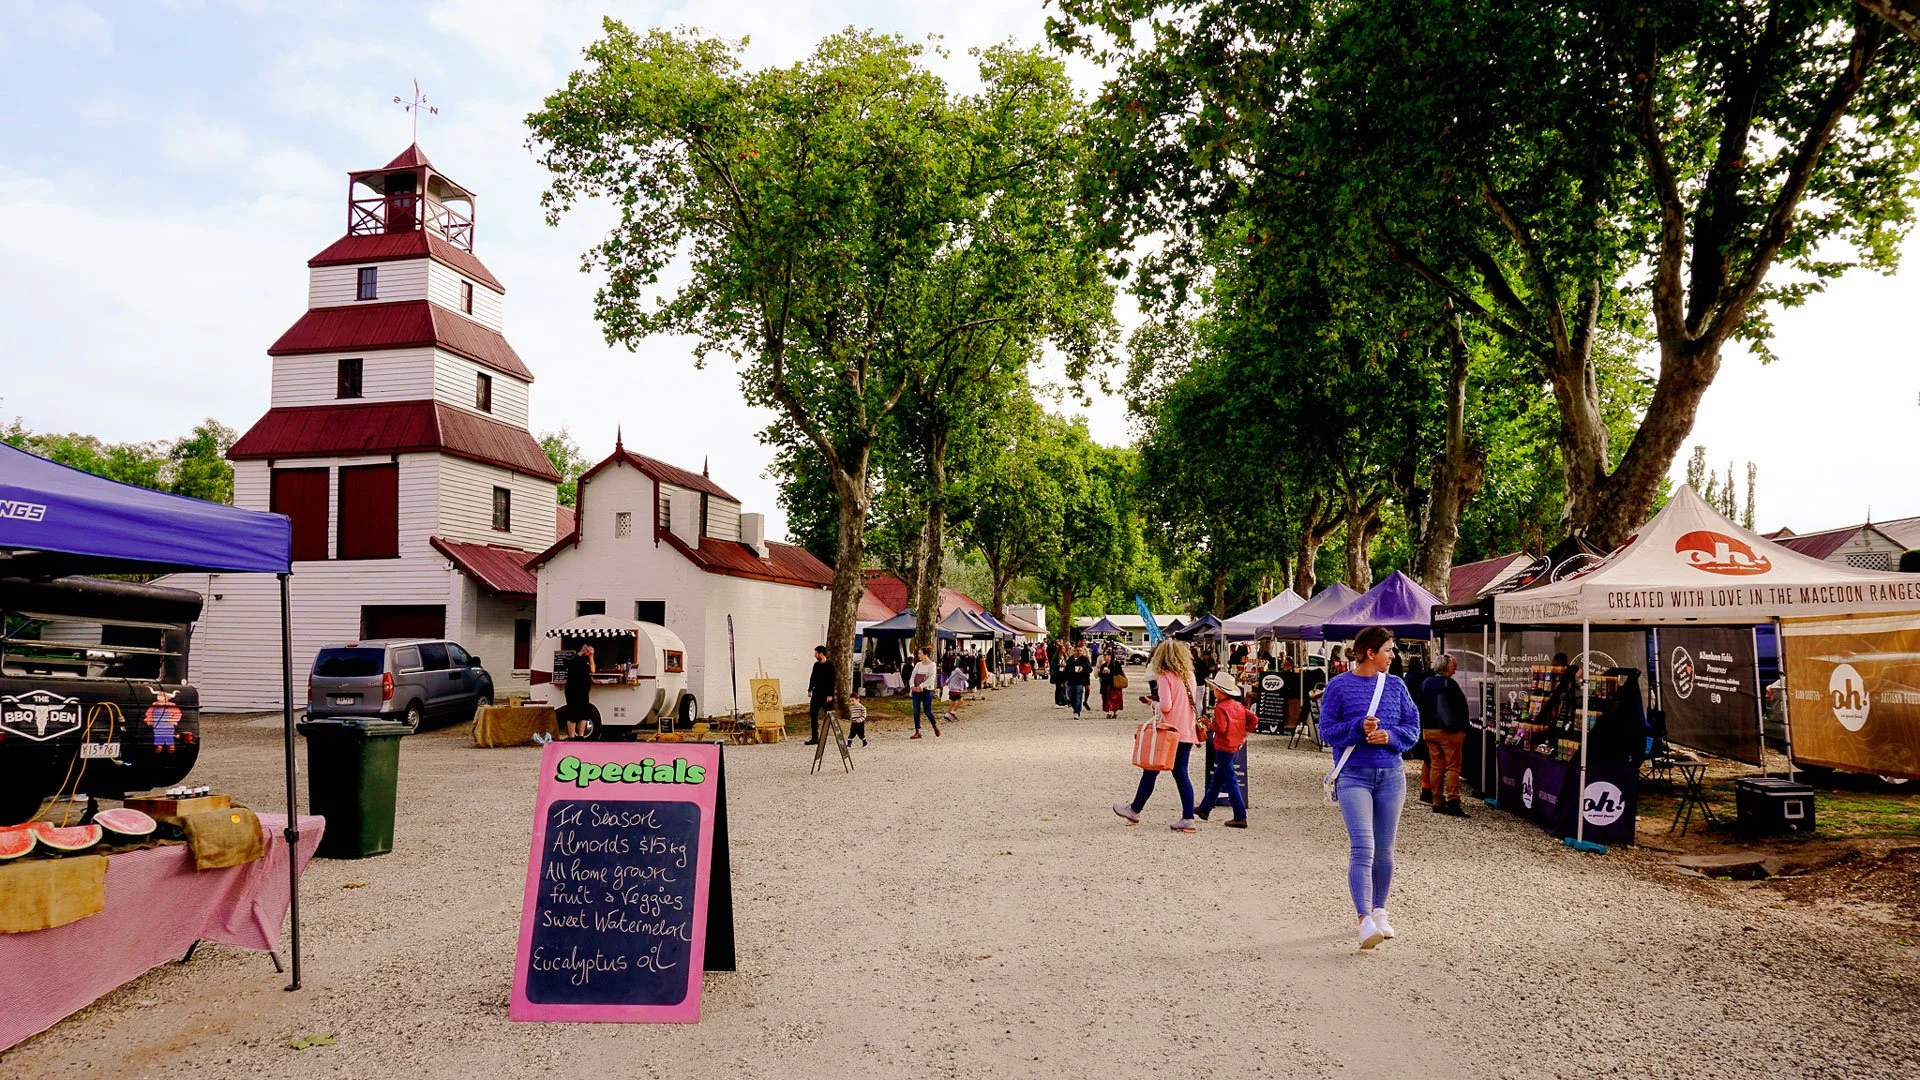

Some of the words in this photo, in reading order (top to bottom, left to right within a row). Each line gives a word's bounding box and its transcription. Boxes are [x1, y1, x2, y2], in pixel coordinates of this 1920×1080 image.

[1608, 591, 1665, 609] CREATED
[1671, 590, 1704, 607] WITH
[1711, 589, 1743, 606] LOVE
[1750, 588, 1763, 605] IN
[1769, 588, 1793, 605] THE
[1800, 585, 1863, 604] MACEDON
[1870, 582, 1920, 601] RANGES
[33, 695, 50, 703] THE
[5, 711, 34, 723] BBQ
[50, 711, 77, 724] DEN
[554, 756, 707, 788] Specials
[553, 803, 583, 828] In
[591, 803, 662, 829] Season
[552, 831, 630, 856] Almonds
[545, 861, 567, 881] All
[570, 859, 608, 881] home
[613, 868, 676, 890] grown
[549, 882, 594, 905] fruit
[542, 909, 590, 929] Sweet
[594, 909, 693, 941] Watermelon
[533, 946, 628, 986] Eucalyptus
